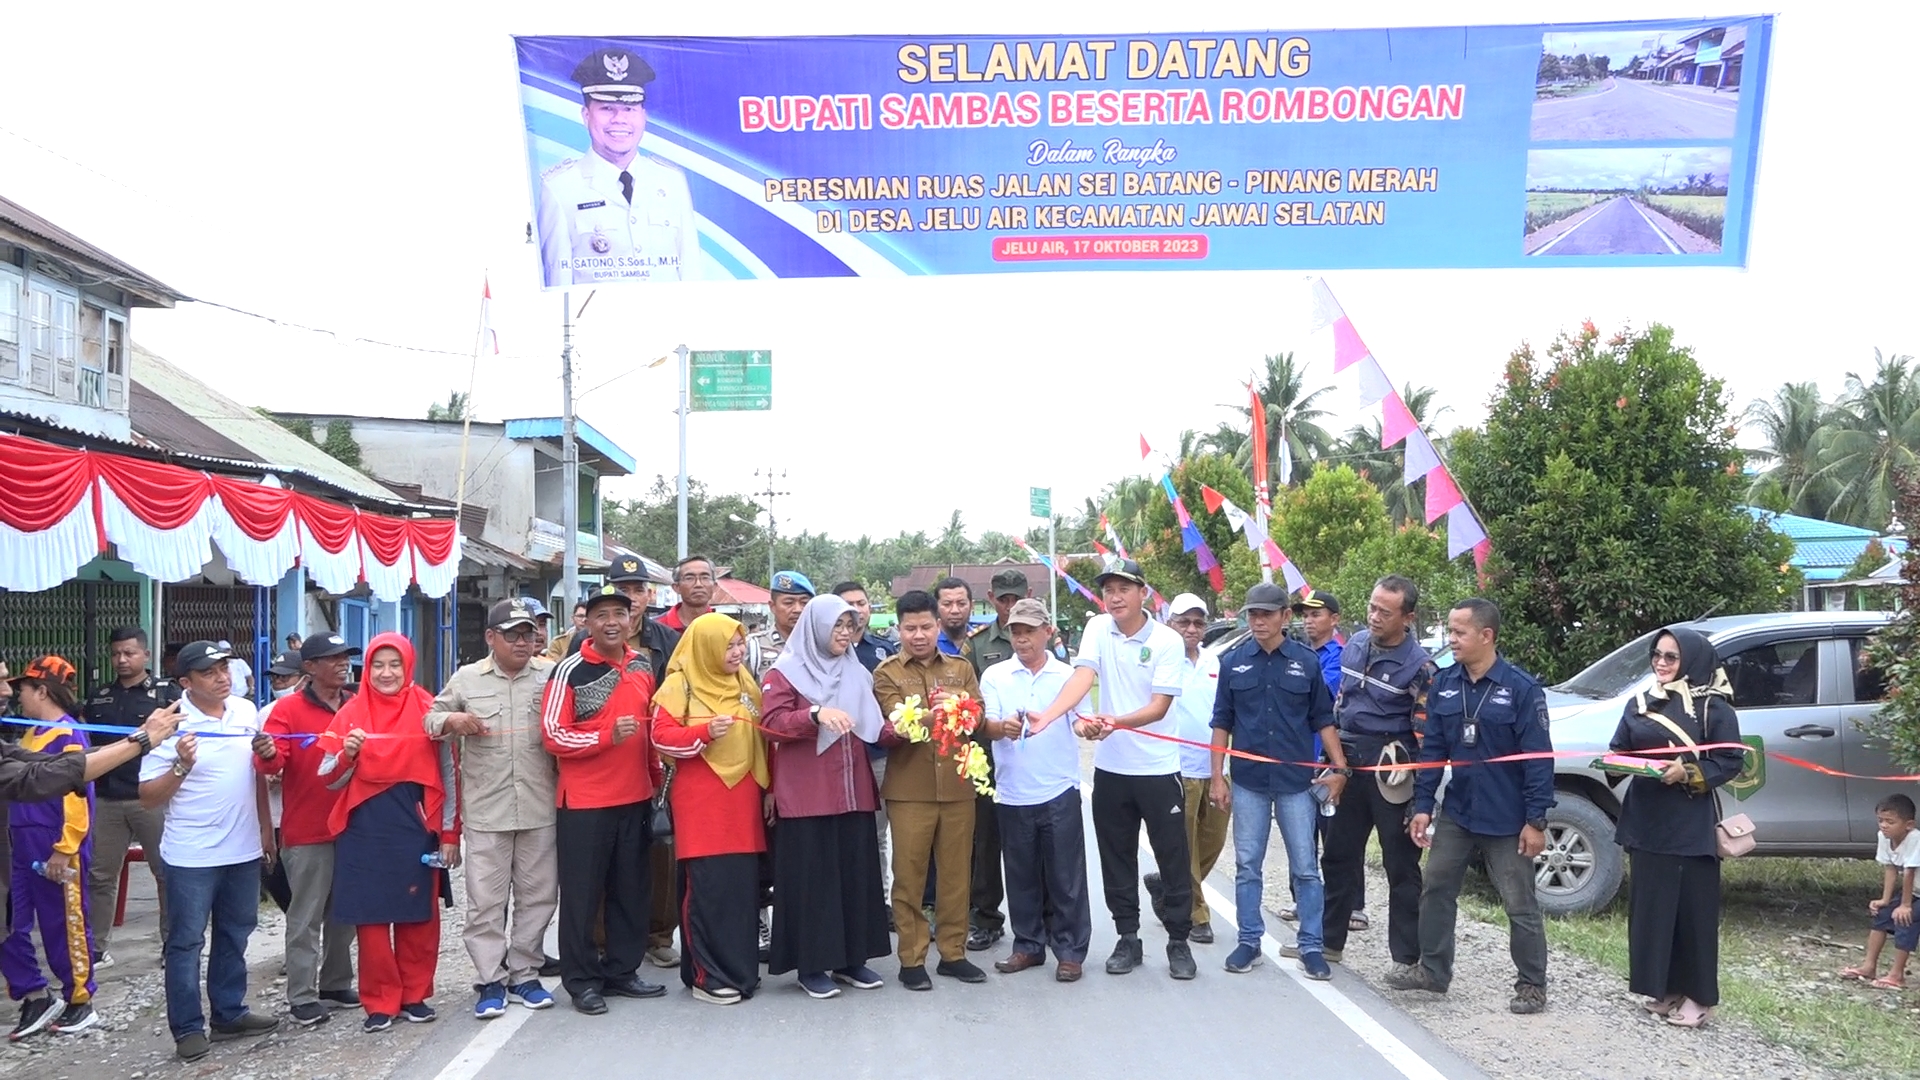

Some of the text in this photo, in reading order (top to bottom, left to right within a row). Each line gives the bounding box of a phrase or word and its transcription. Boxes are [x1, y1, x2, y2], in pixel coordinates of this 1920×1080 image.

[897, 37, 1311, 83] SELAMAT DATANG
[739, 84, 1465, 133] BUPATI SAMBAS BESERTA ROMBONGAN
[1026, 138, 1177, 167] Dalam Rangka
[764, 176, 909, 201] PERESMIAN
[915, 175, 985, 200] RUAS
[990, 173, 1072, 199] JALAN
[1078, 172, 1117, 197] SEI
[1124, 171, 1221, 196] BATANG
[1244, 168, 1341, 194] PINANG
[1347, 167, 1438, 193] MERAH
[816, 201, 1386, 234] DI DESA JELU AIR KECAMATAN JAWAI SELATAN
[561, 260, 571, 269] H.
[574, 258, 616, 269] SATONO,
[659, 255, 682, 266] M.H.
[1001, 237, 1199, 257] JELU AIR, 17 OKTOBER 2023
[594, 269, 651, 278] BUPATI SAMBAS
